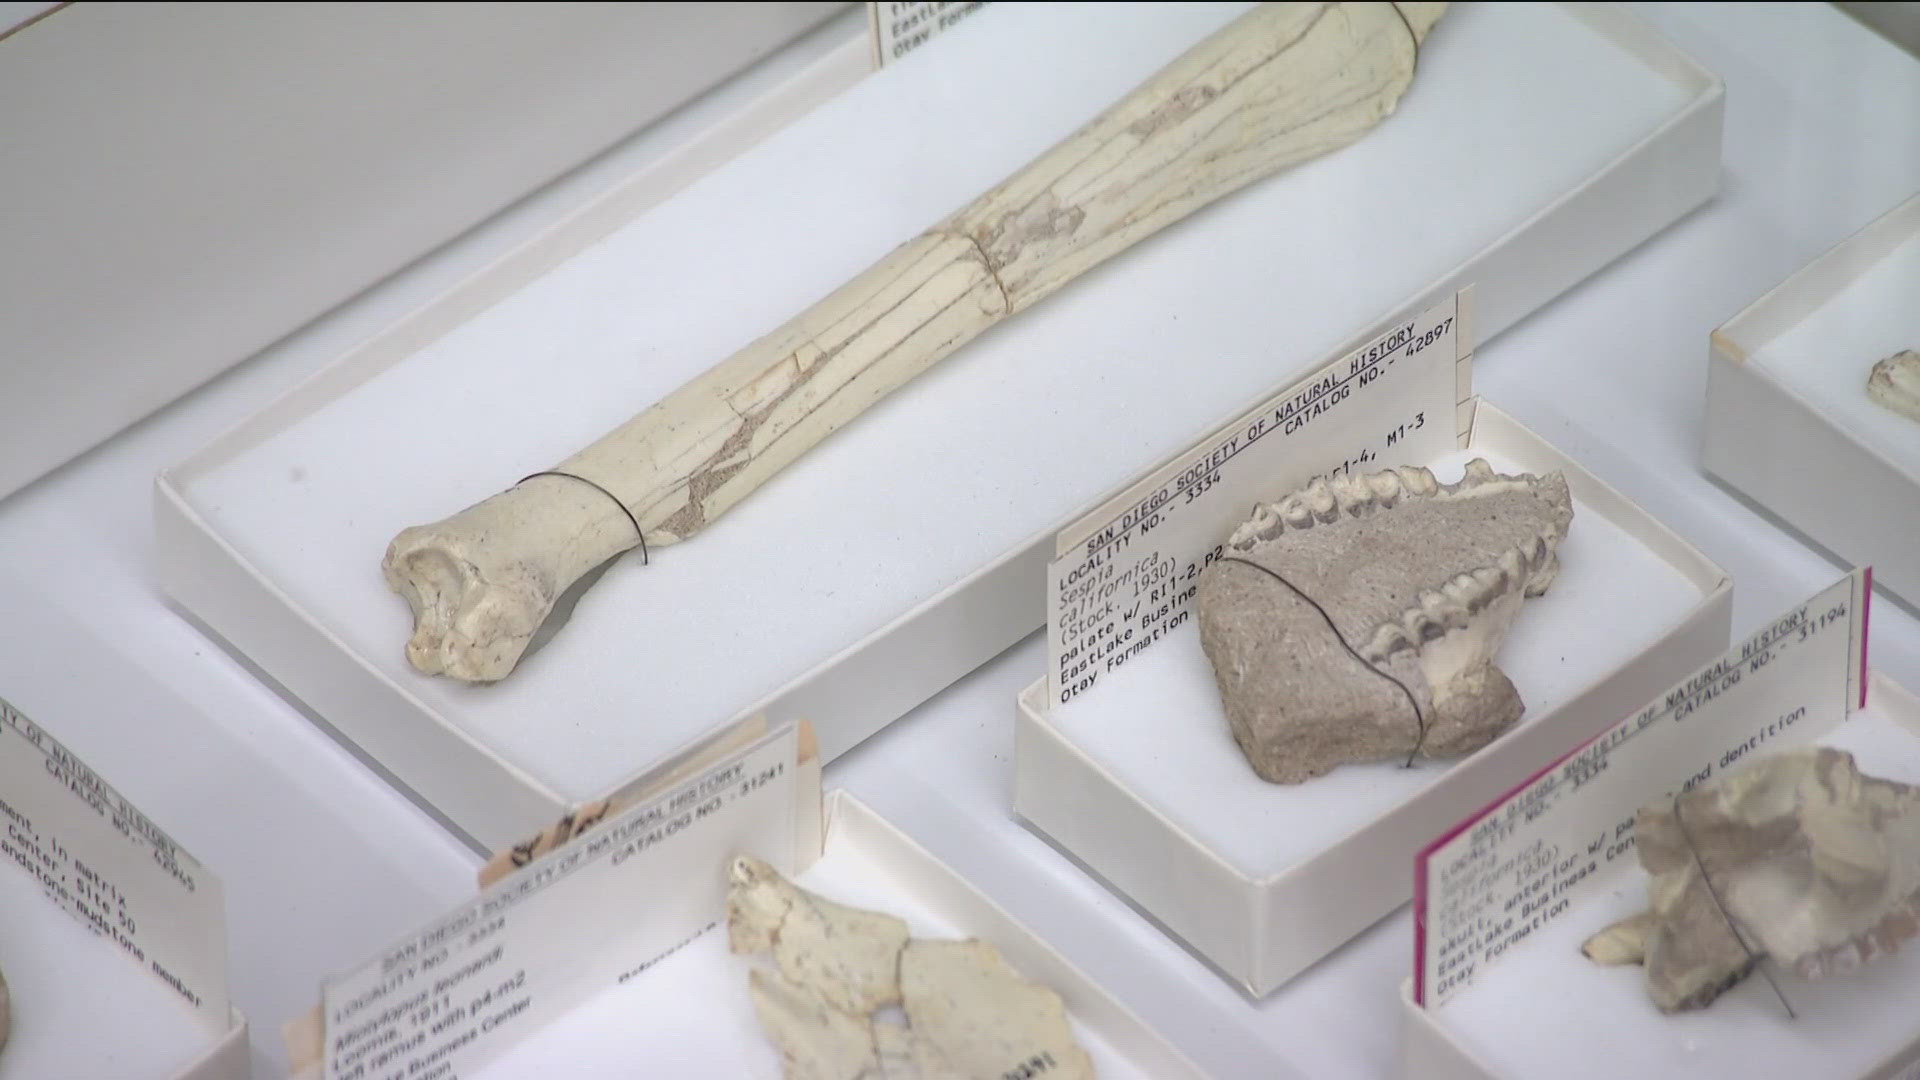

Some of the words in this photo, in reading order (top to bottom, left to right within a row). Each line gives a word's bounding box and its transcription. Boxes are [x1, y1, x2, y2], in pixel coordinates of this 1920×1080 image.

[1285, 385, 1350, 436] CATALOG
[1405, 317, 1453, 357] 42897
[1087, 527, 1114, 553] SAN
[1122, 489, 1168, 530] DIEGO
[1177, 437, 1238, 490] SOCIETY
[1248, 419, 1265, 440] OF
[1275, 373, 1339, 422] NATURAL
[1350, 323, 1415, 375] HISTORY
[1060, 533, 1131, 591] LOCALITY
[1185, 469, 1221, 505] 3334
[1060, 622, 1114, 670] palate
[1124, 600, 1140, 622] w/
[1387, 411, 1425, 447] M1-3
[1059, 551, 1158, 629] californica
[1133, 557, 1176, 598] 1930)
[1142, 585, 1197, 630] Busine
[1061, 670, 1098, 705] Otay
[1107, 610, 1189, 674] Formation
[1637, 705, 1656, 730] OF
[1665, 658, 1731, 708] NATURAL
[1741, 606, 1808, 659] HISTORY
[1674, 670, 1741, 722] CATALOG
[45, 758, 104, 817] CATALOG
[53, 745, 108, 801] NATURAL
[119, 799, 176, 861] HISTORY
[1504, 853, 1578, 912] anterior
[1587, 831, 1605, 855] w/
[1682, 763, 1712, 793] and
[1719, 705, 1806, 769] dentition
[52, 836, 68, 861] in
[75, 859, 127, 909] matrix
[611, 813, 693, 866] CATALOG
[1522, 860, 1596, 919] Business
[1606, 835, 1636, 861] Cen
[0, 840, 145, 962] andstone-mudstone
[152, 960, 202, 1008] member
[76, 877, 110, 915] Site
[1437, 962, 1475, 995] Otay
[1485, 899, 1569, 962] Formation
[431, 1006, 465, 1035] with
[481, 996, 531, 1033] Center
